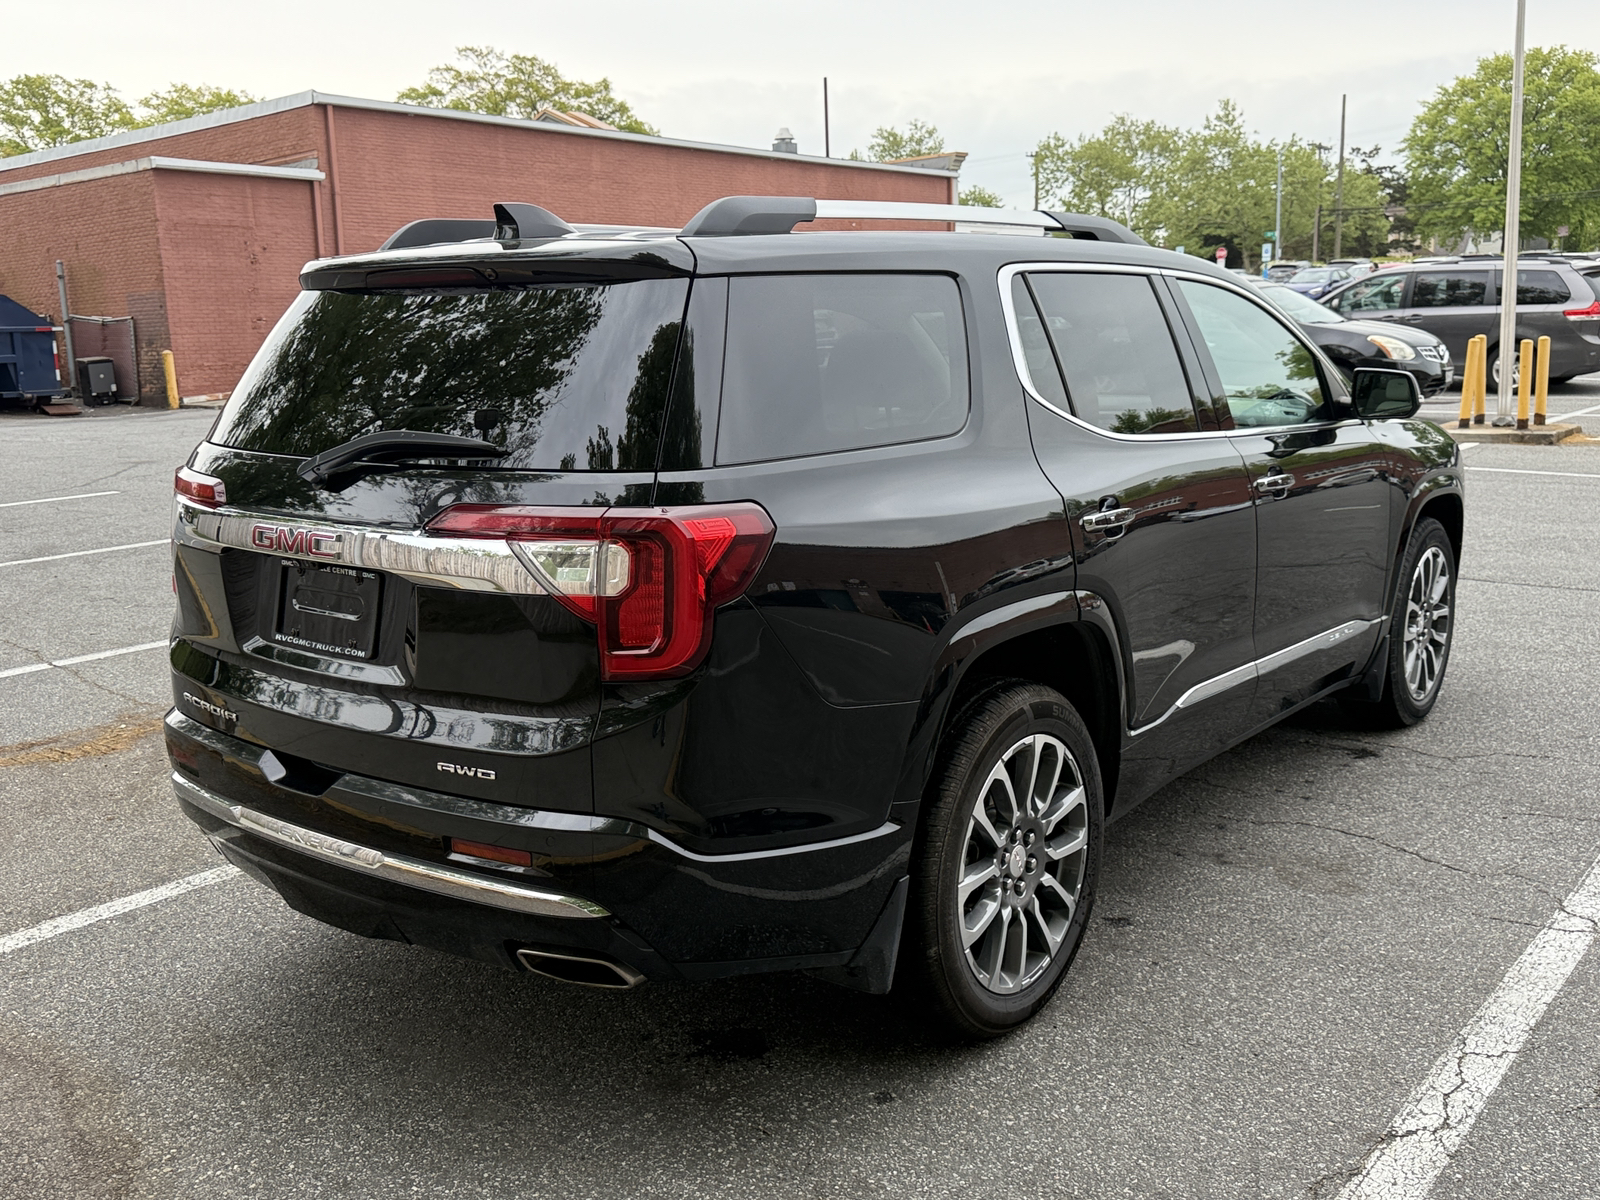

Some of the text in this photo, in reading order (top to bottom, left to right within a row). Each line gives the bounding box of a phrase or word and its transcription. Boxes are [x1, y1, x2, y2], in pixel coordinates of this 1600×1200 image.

[252, 523, 336, 558] GMC
[332, 566, 357, 577] CENTRE
[274, 633, 366, 658] RVCGMCTRUCK.COM
[183, 691, 237, 722] ACADIA
[437, 762, 496, 780] AWD
